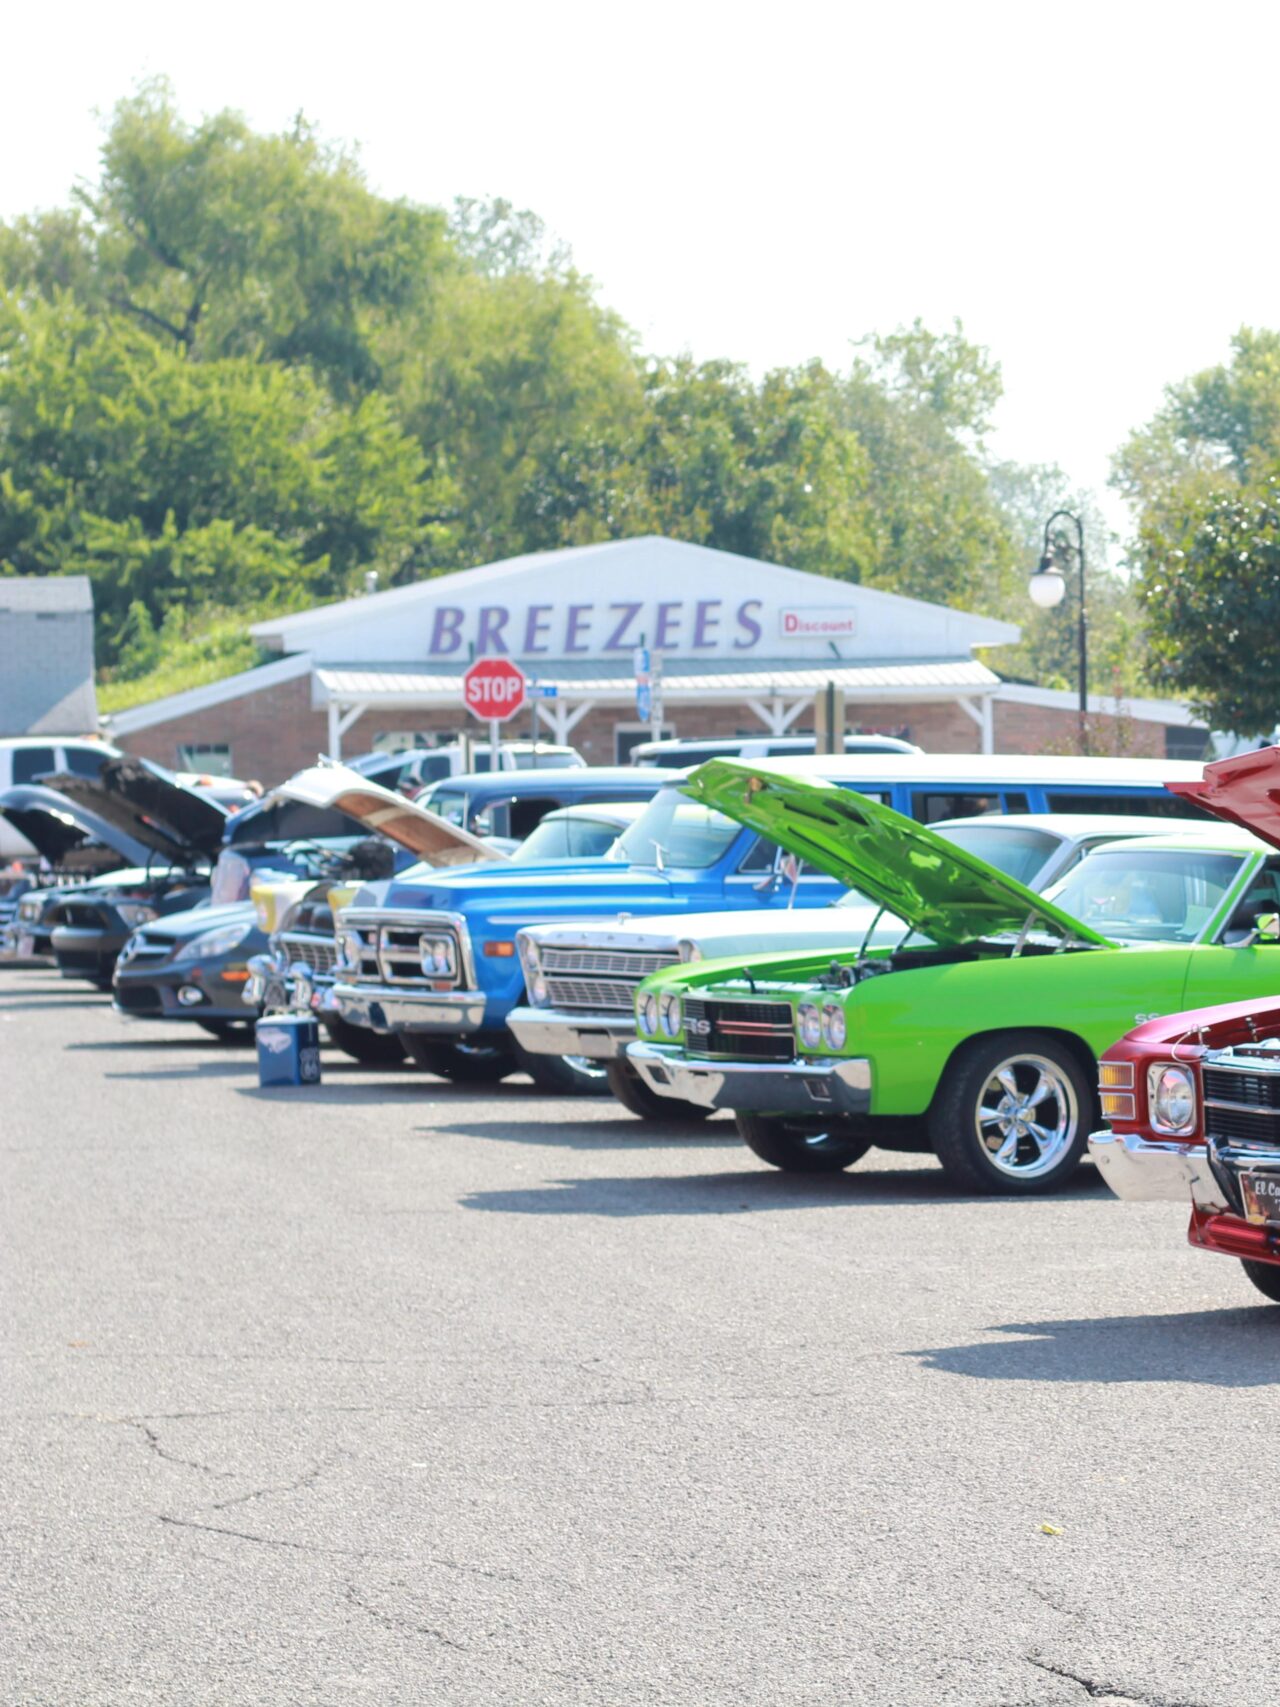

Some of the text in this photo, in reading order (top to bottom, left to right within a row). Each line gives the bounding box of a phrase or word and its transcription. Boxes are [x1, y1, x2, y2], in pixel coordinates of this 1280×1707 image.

[428, 600, 763, 656] BREEZEES
[784, 613, 853, 633] Discount
[467, 676, 522, 703] STOP
[1254, 1180, 1266, 1196] El
